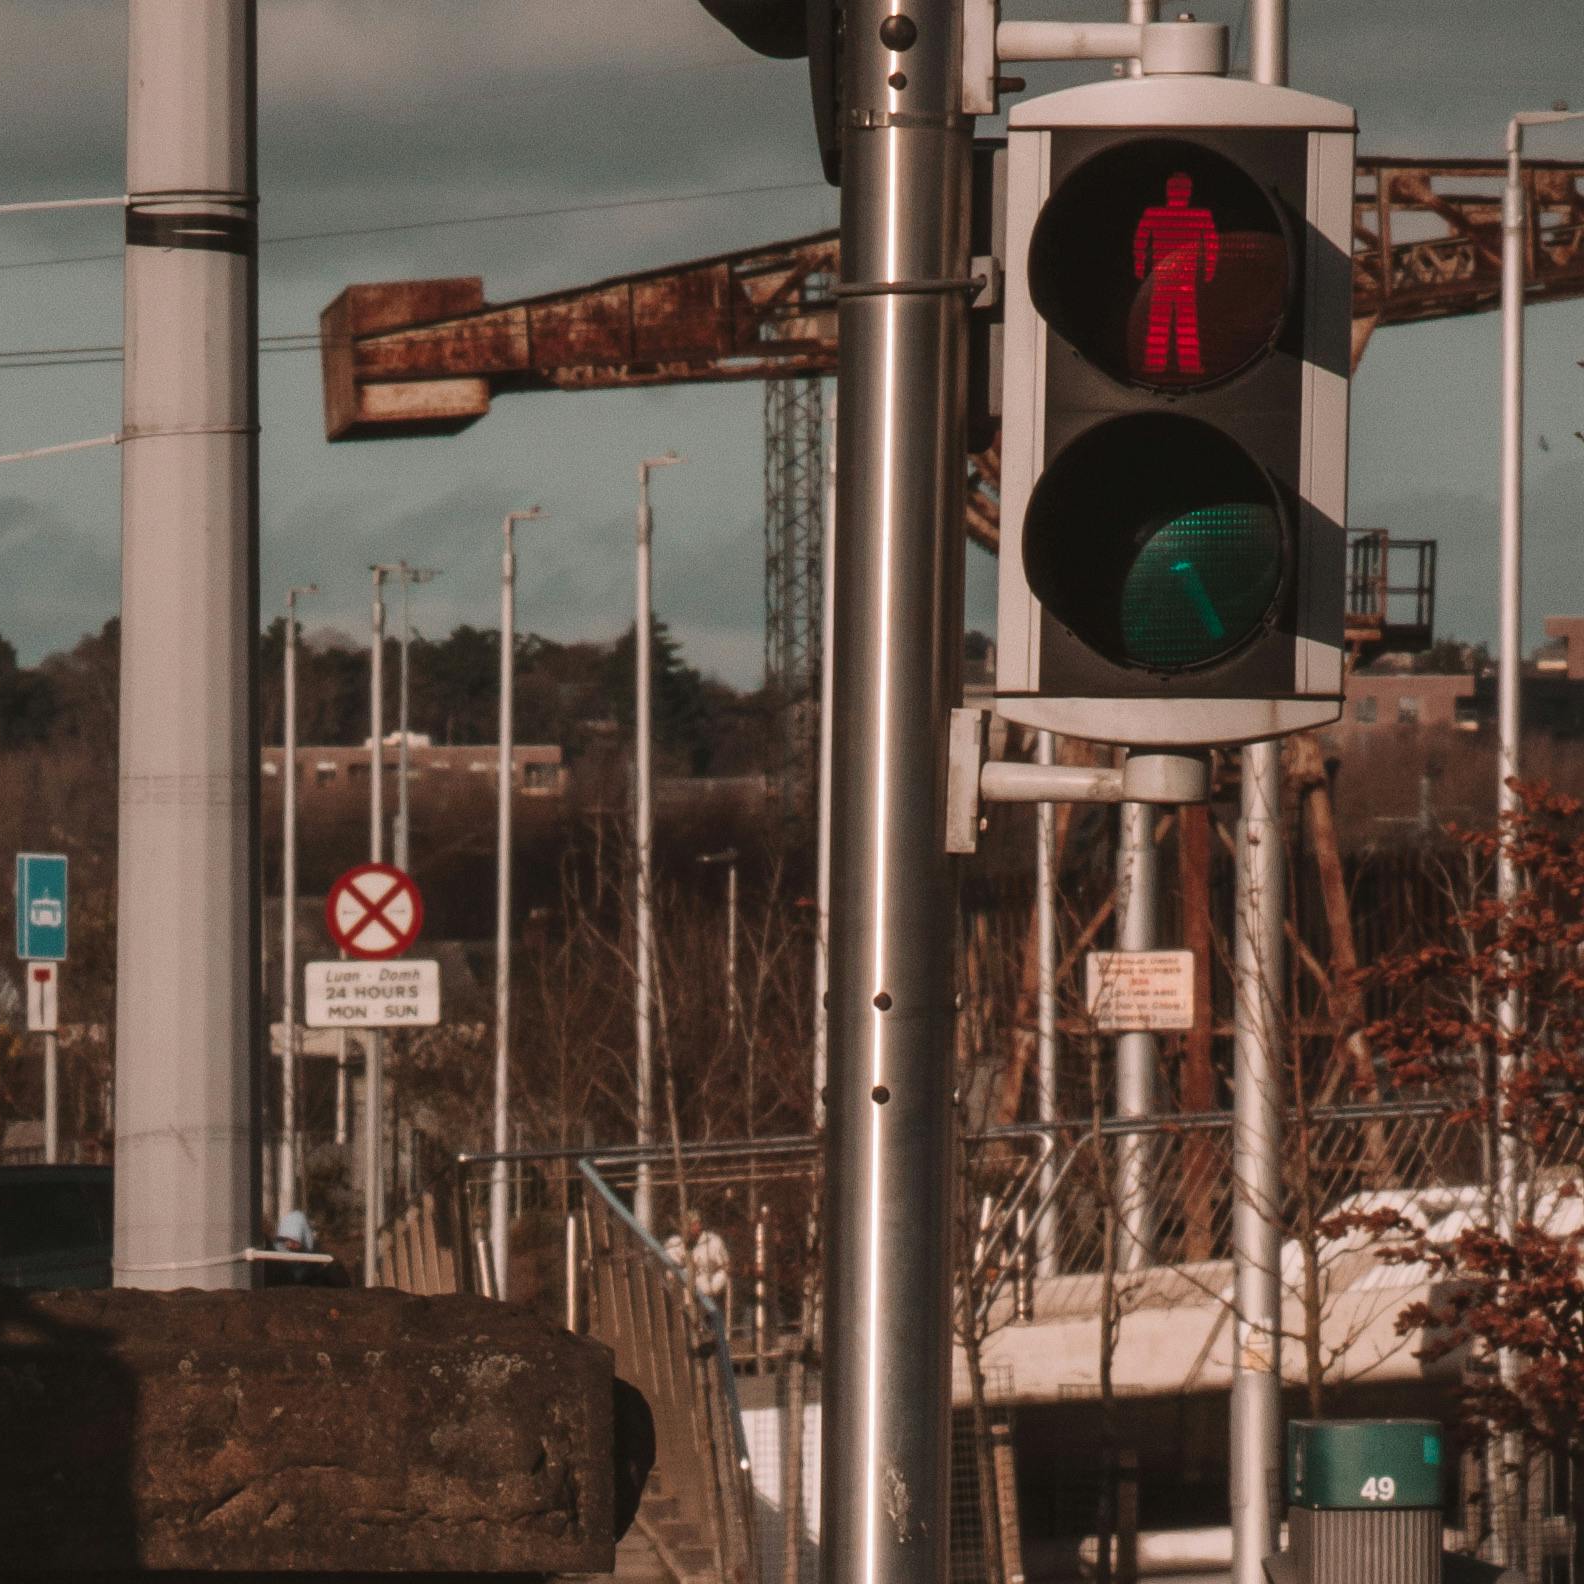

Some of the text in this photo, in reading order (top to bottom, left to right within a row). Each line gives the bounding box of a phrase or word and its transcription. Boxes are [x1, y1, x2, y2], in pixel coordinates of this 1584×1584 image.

[326, 985, 419, 1000] 24 HOURS
[328, 1005, 419, 1019] MON SUN
[1360, 1476, 1395, 1501] 49
